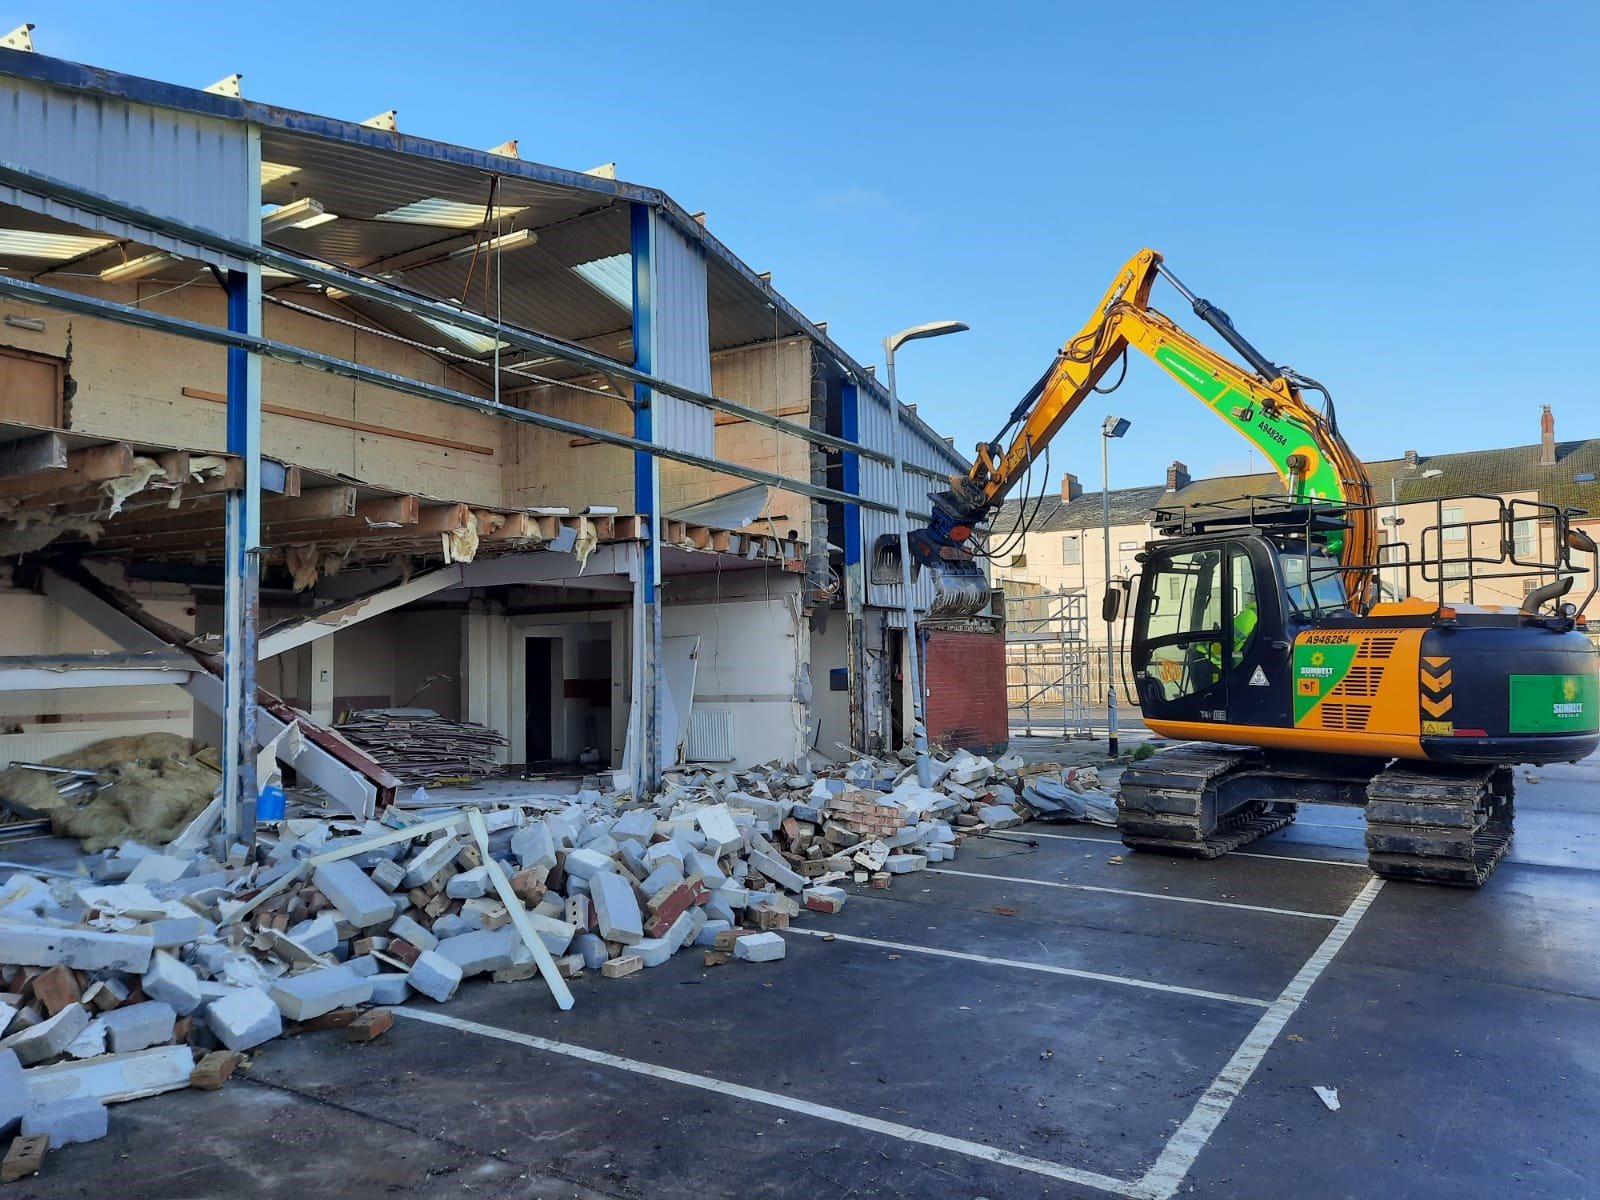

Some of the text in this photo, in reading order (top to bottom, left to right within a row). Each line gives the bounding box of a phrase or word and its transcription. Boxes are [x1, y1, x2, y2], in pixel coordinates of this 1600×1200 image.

[1257, 421, 1288, 446] A948284
[1304, 634, 1350, 645] A948284
[1300, 667, 1334, 675] SUNBELT
[1553, 703, 1583, 713] SUNBELT
